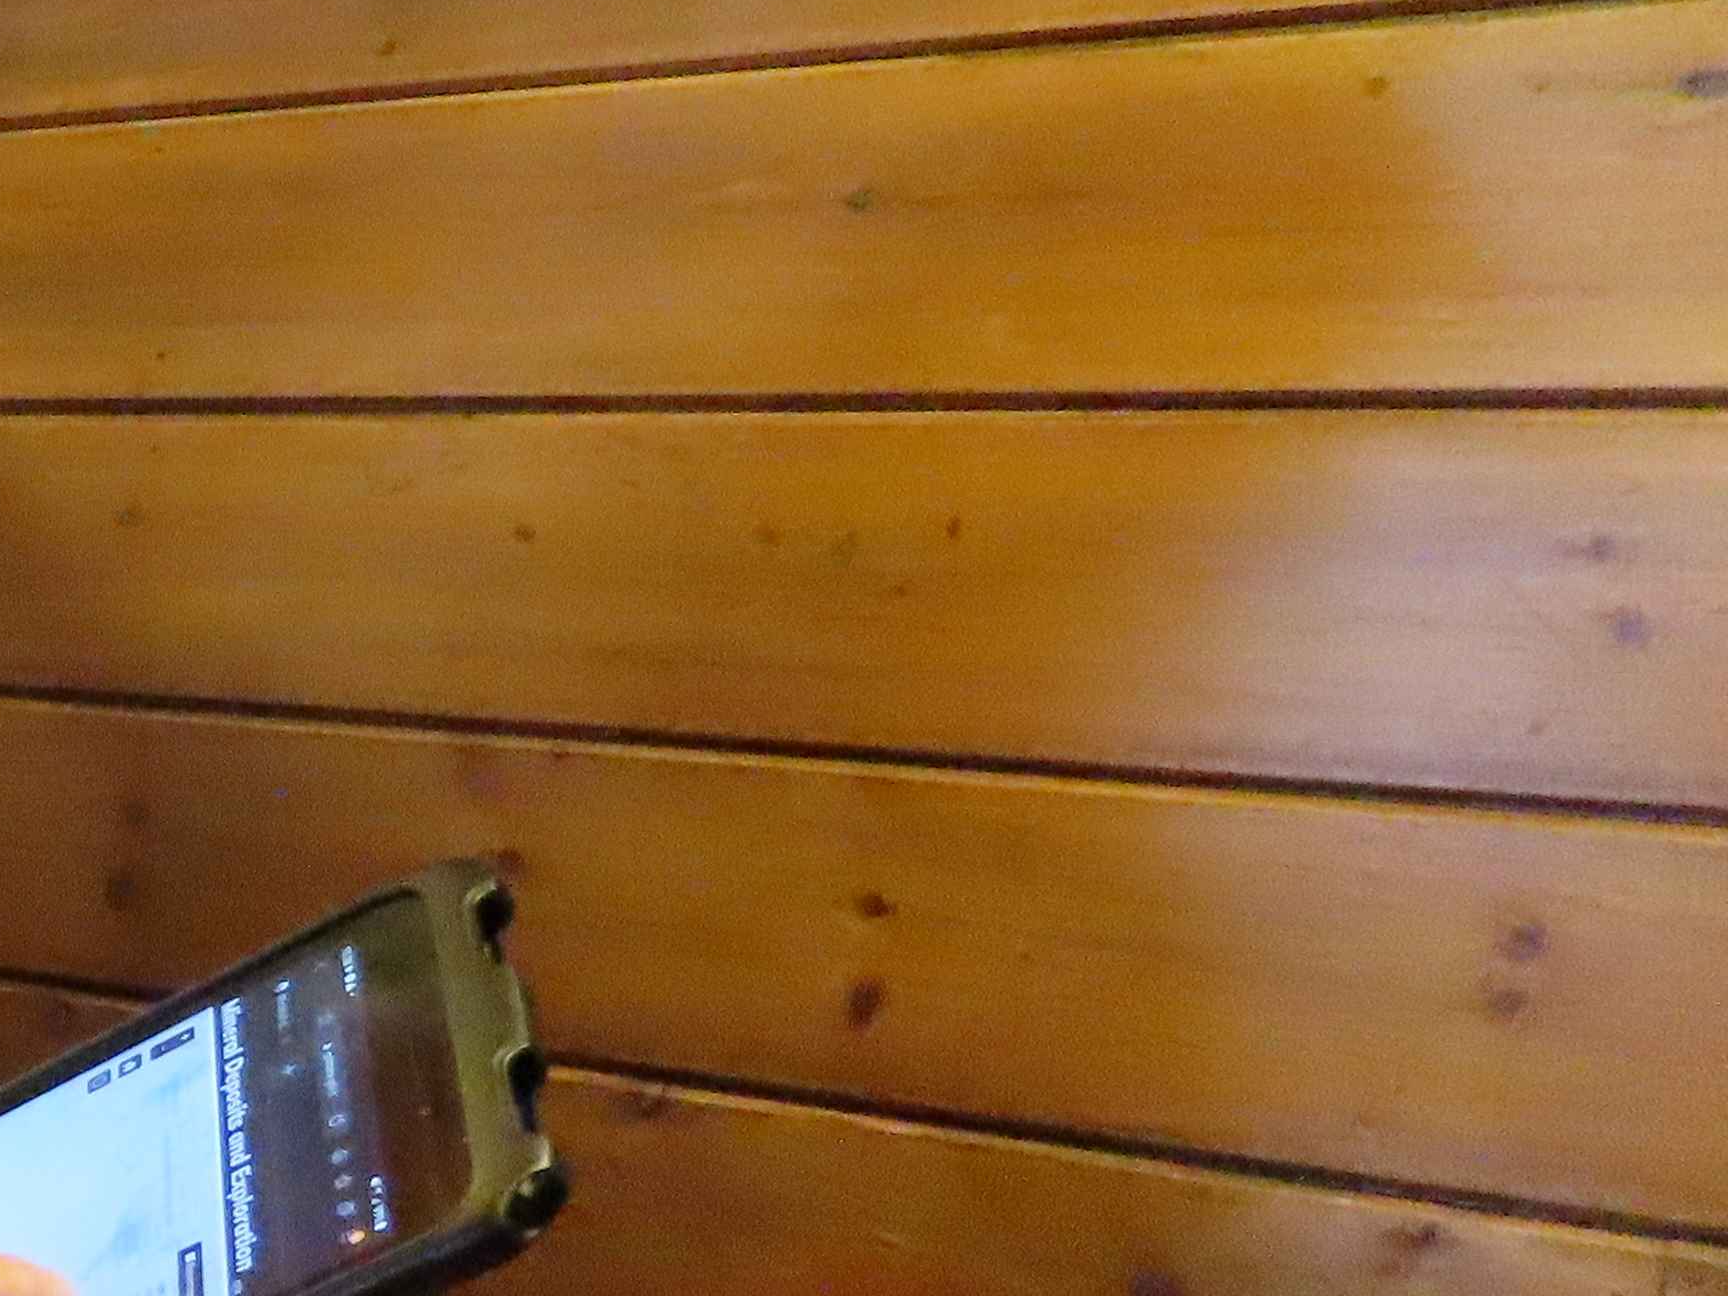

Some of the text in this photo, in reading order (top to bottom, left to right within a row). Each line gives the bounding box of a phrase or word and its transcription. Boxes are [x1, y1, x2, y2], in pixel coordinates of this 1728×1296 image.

[220, 997, 243, 1058] Mineral
[219, 1060, 248, 1130] Deposits
[228, 1132, 251, 1167] and
[226, 1167, 257, 1272] Exploration
